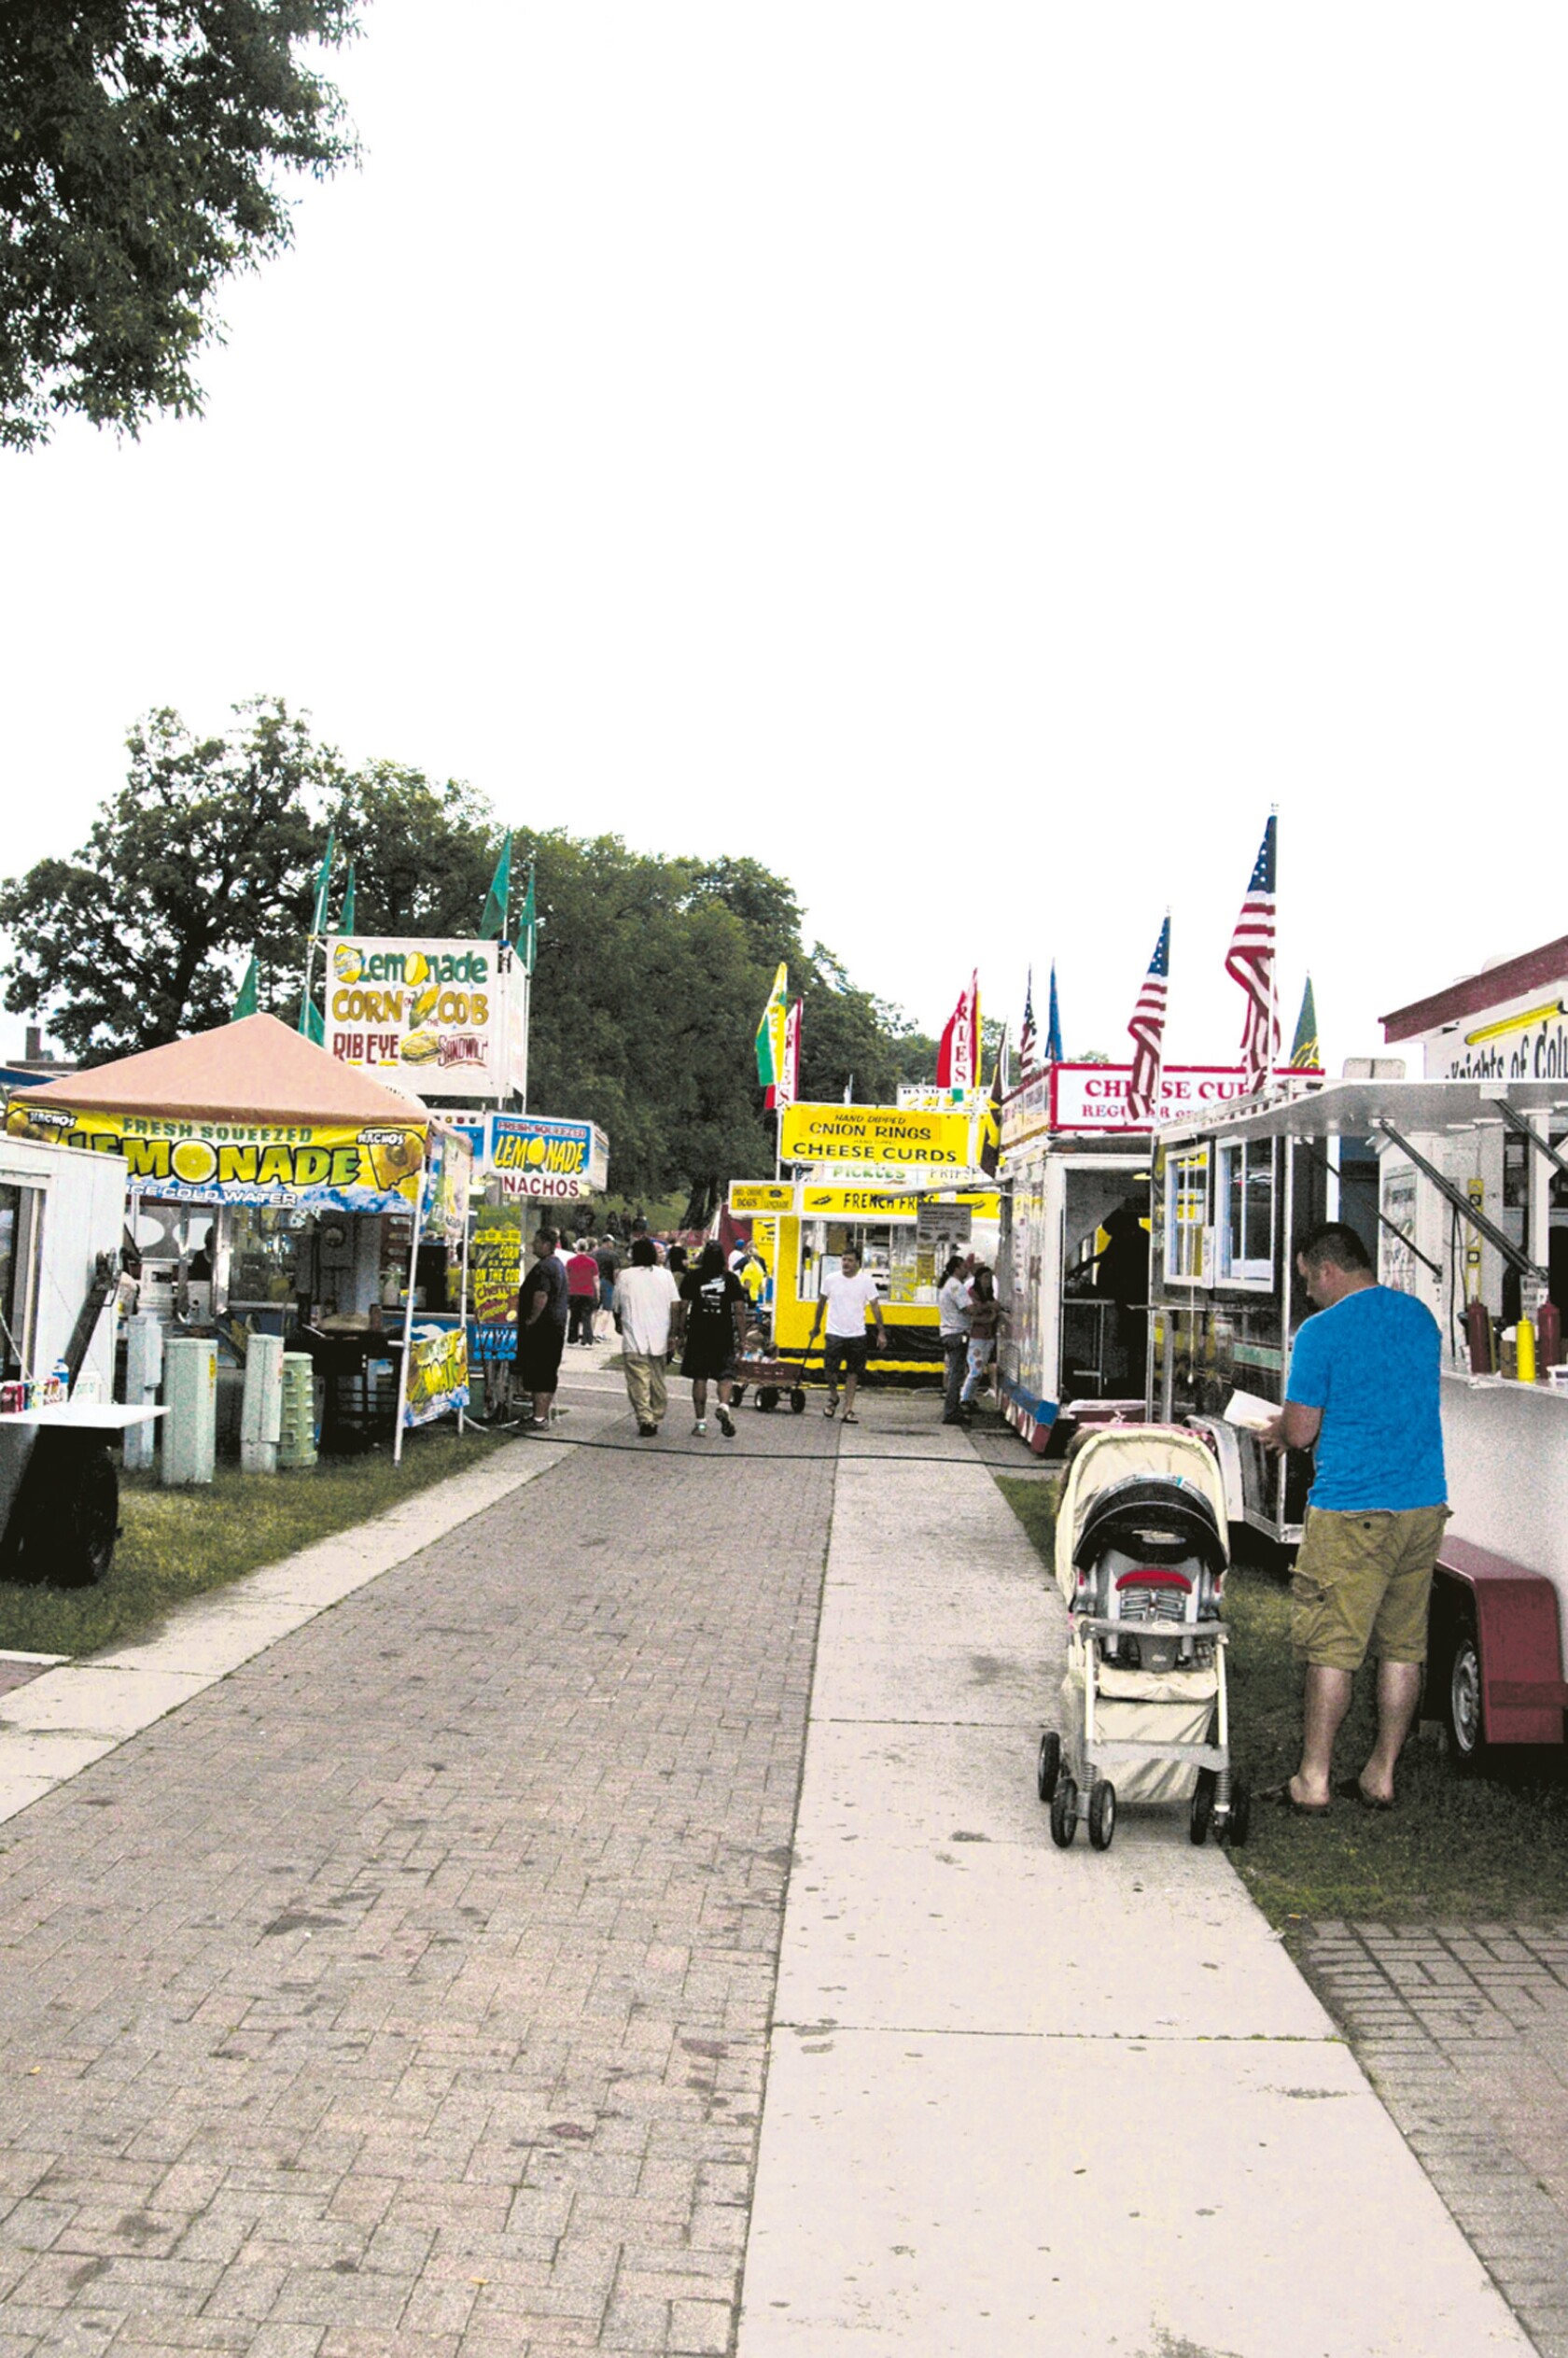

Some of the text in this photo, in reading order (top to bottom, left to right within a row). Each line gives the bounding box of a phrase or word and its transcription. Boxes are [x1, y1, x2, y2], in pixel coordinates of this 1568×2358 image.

[332, 988, 404, 1024] CORN
[437, 990, 490, 1026] COB
[332, 1032, 364, 1062] RIB
[367, 1033, 399, 1064] EYE
[955, 1004, 968, 1083] RIES
[1085, 1079, 1191, 1099] CHSE
[27, 1110, 77, 1128] NACHOS
[497, 1120, 531, 1132] FRESH
[835, 1114, 906, 1125] HAND DIPPED
[122, 1117, 313, 1144] FRESH SQUEEZED
[356, 1130, 406, 1146] NACHOS
[875, 1126, 931, 1140] RINGS
[494, 1134, 587, 1174] LEMONADE
[793, 1143, 958, 1163] CHEESE CURDS
[161, 1186, 219, 1200] COLD
[224, 1189, 298, 1205] WATER
[505, 1176, 580, 1197] NACHOS
[844, 1193, 894, 1210] FRENCH
[489, 1268, 503, 1282] THE
